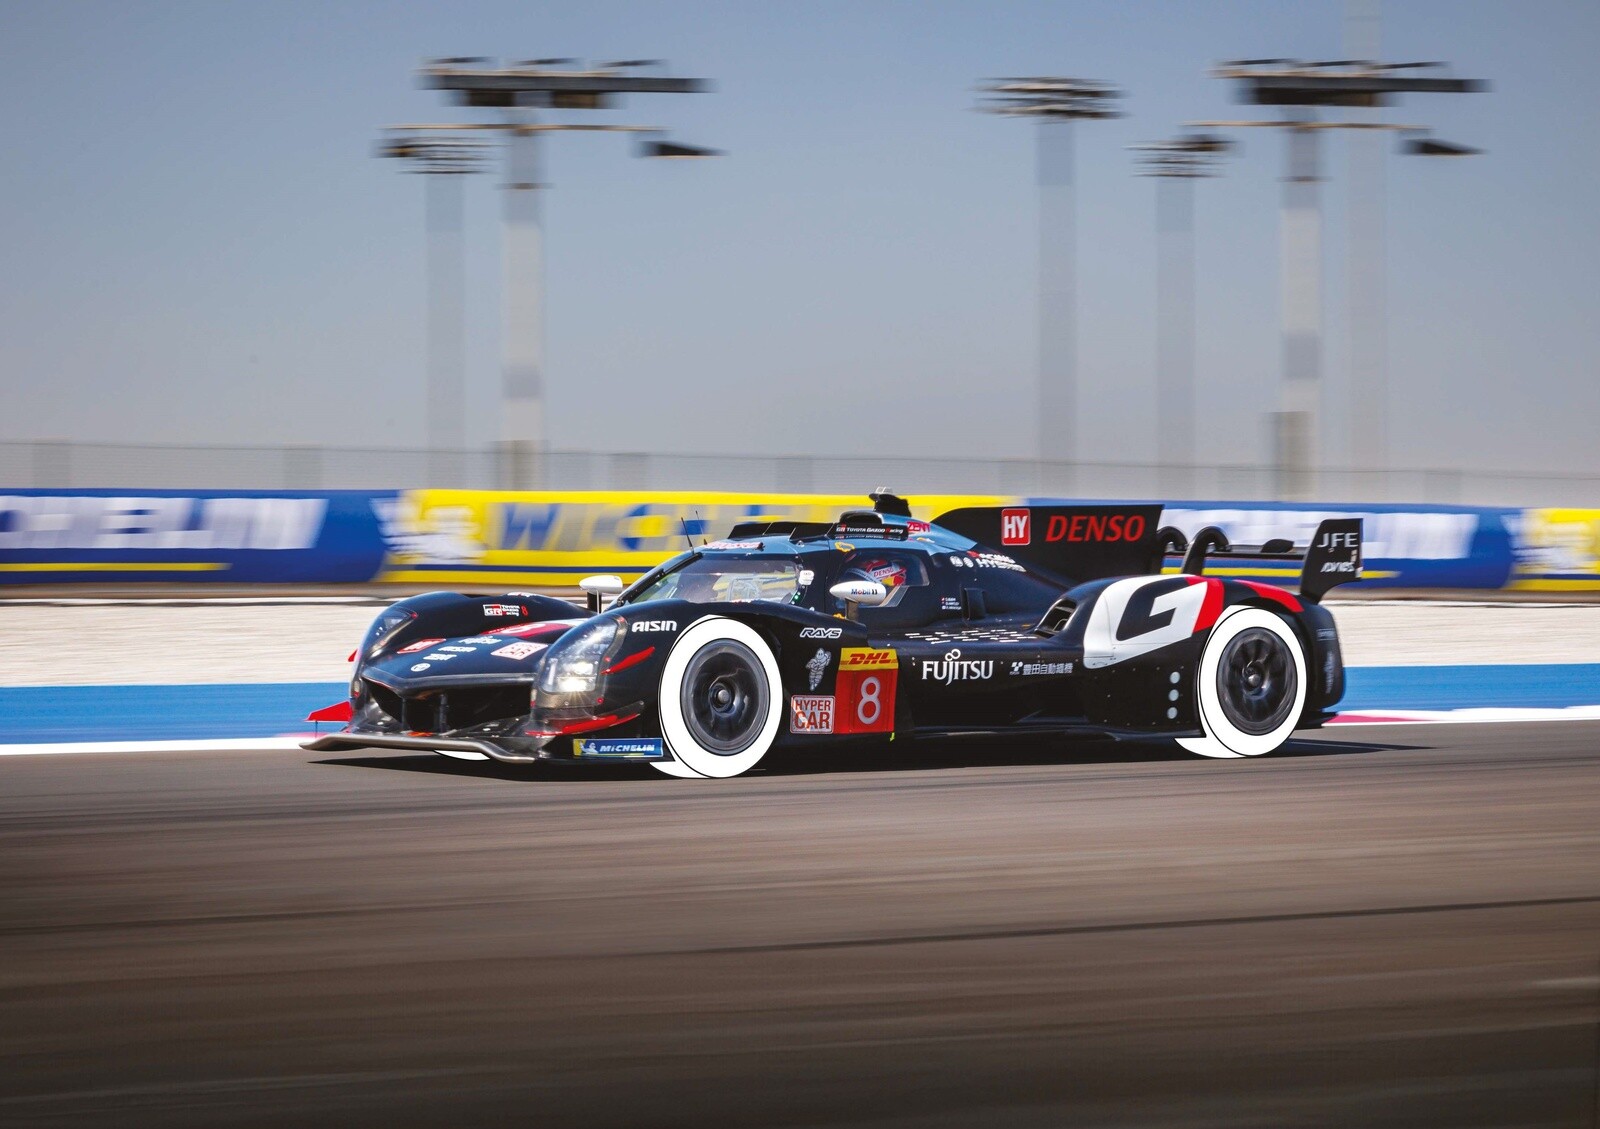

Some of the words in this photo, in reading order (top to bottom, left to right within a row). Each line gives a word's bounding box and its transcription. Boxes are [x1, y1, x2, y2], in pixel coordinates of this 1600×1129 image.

[1003, 515, 1029, 539] HY
[1045, 515, 1146, 542] DENSO
[1316, 532, 1359, 548] JFE
[631, 620, 678, 632] AISIN
[800, 627, 843, 639] RAYS
[848, 652, 892, 665] DHL
[921, 649, 994, 686] FUJITSU
[795, 699, 831, 711] HYPER
[857, 676, 881, 725] 8
[794, 711, 830, 730] CAR
[599, 744, 655, 752] MICHELIN
